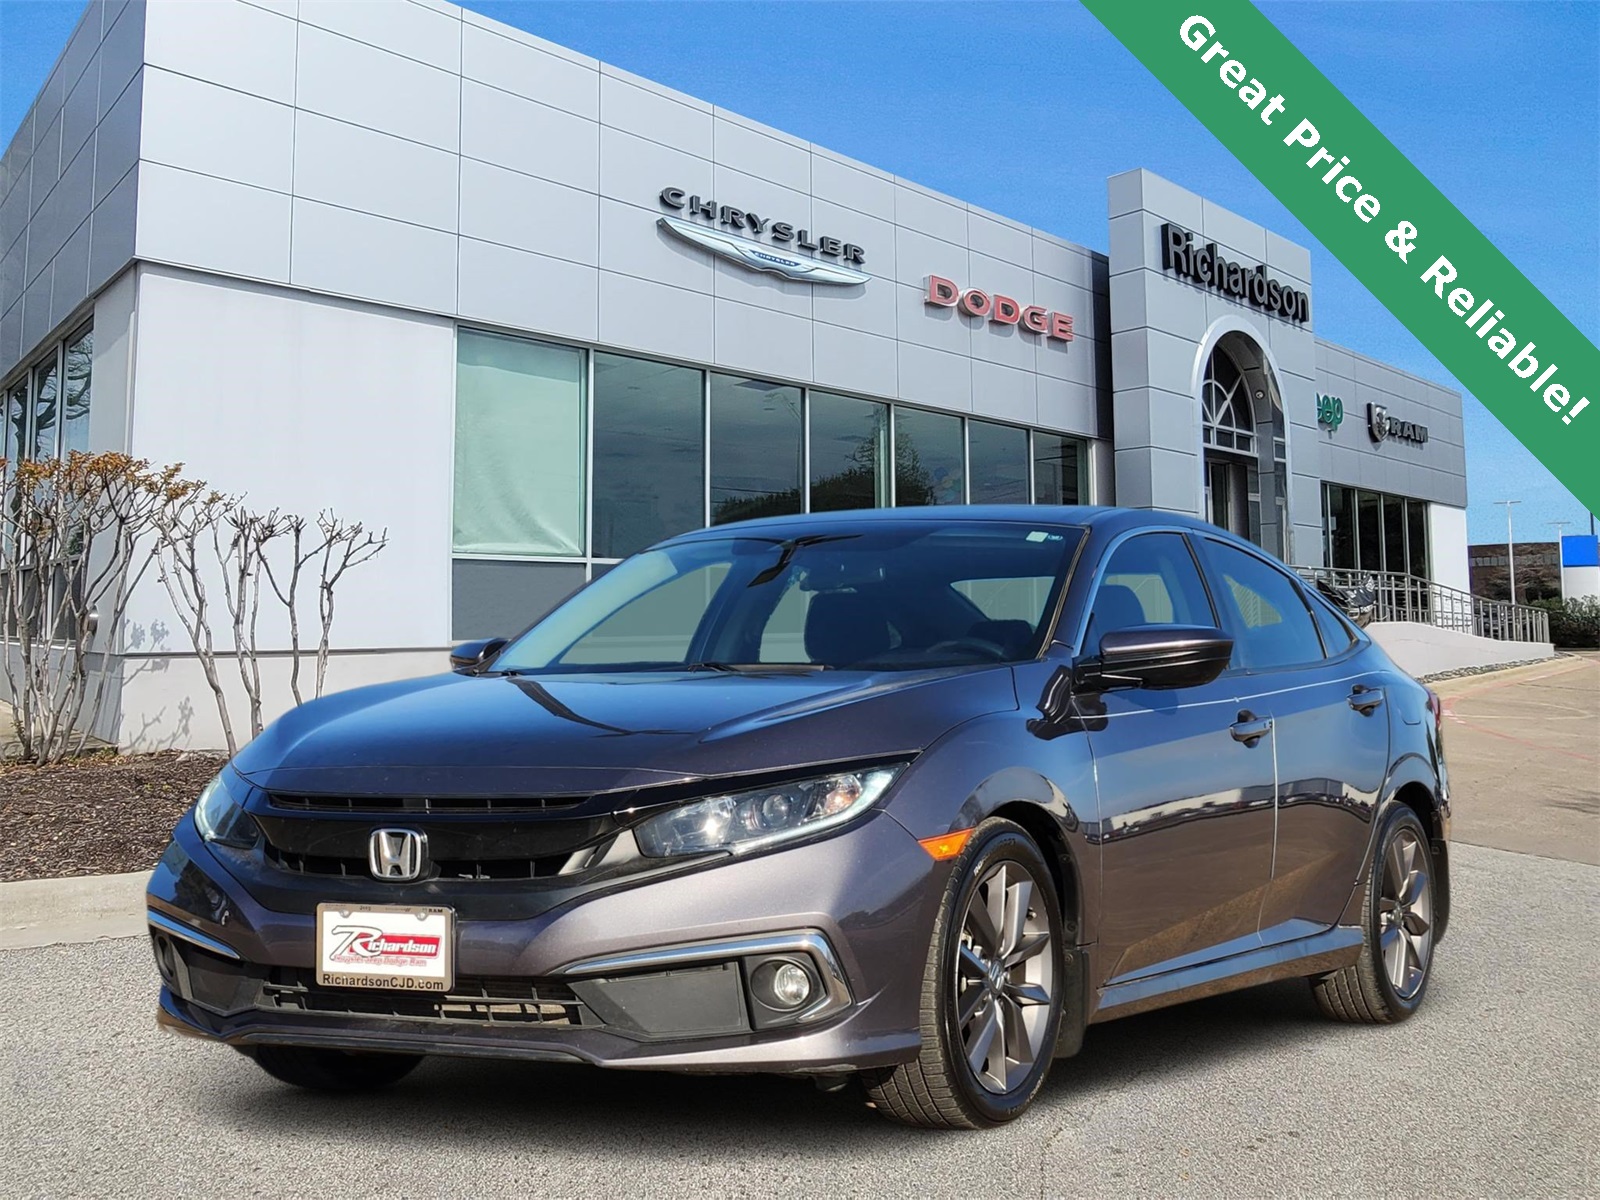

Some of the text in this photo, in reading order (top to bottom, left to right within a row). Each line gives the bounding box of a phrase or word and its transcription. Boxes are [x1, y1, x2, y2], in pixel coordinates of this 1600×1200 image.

[659, 186, 866, 264] CHRYSLER
[1161, 223, 1309, 323] Richardson
[923, 274, 1074, 343] DODGE
[1387, 416, 1429, 443] RAM
[330, 925, 438, 961] Richardson
[322, 973, 445, 991] RichardsonCJD.com
